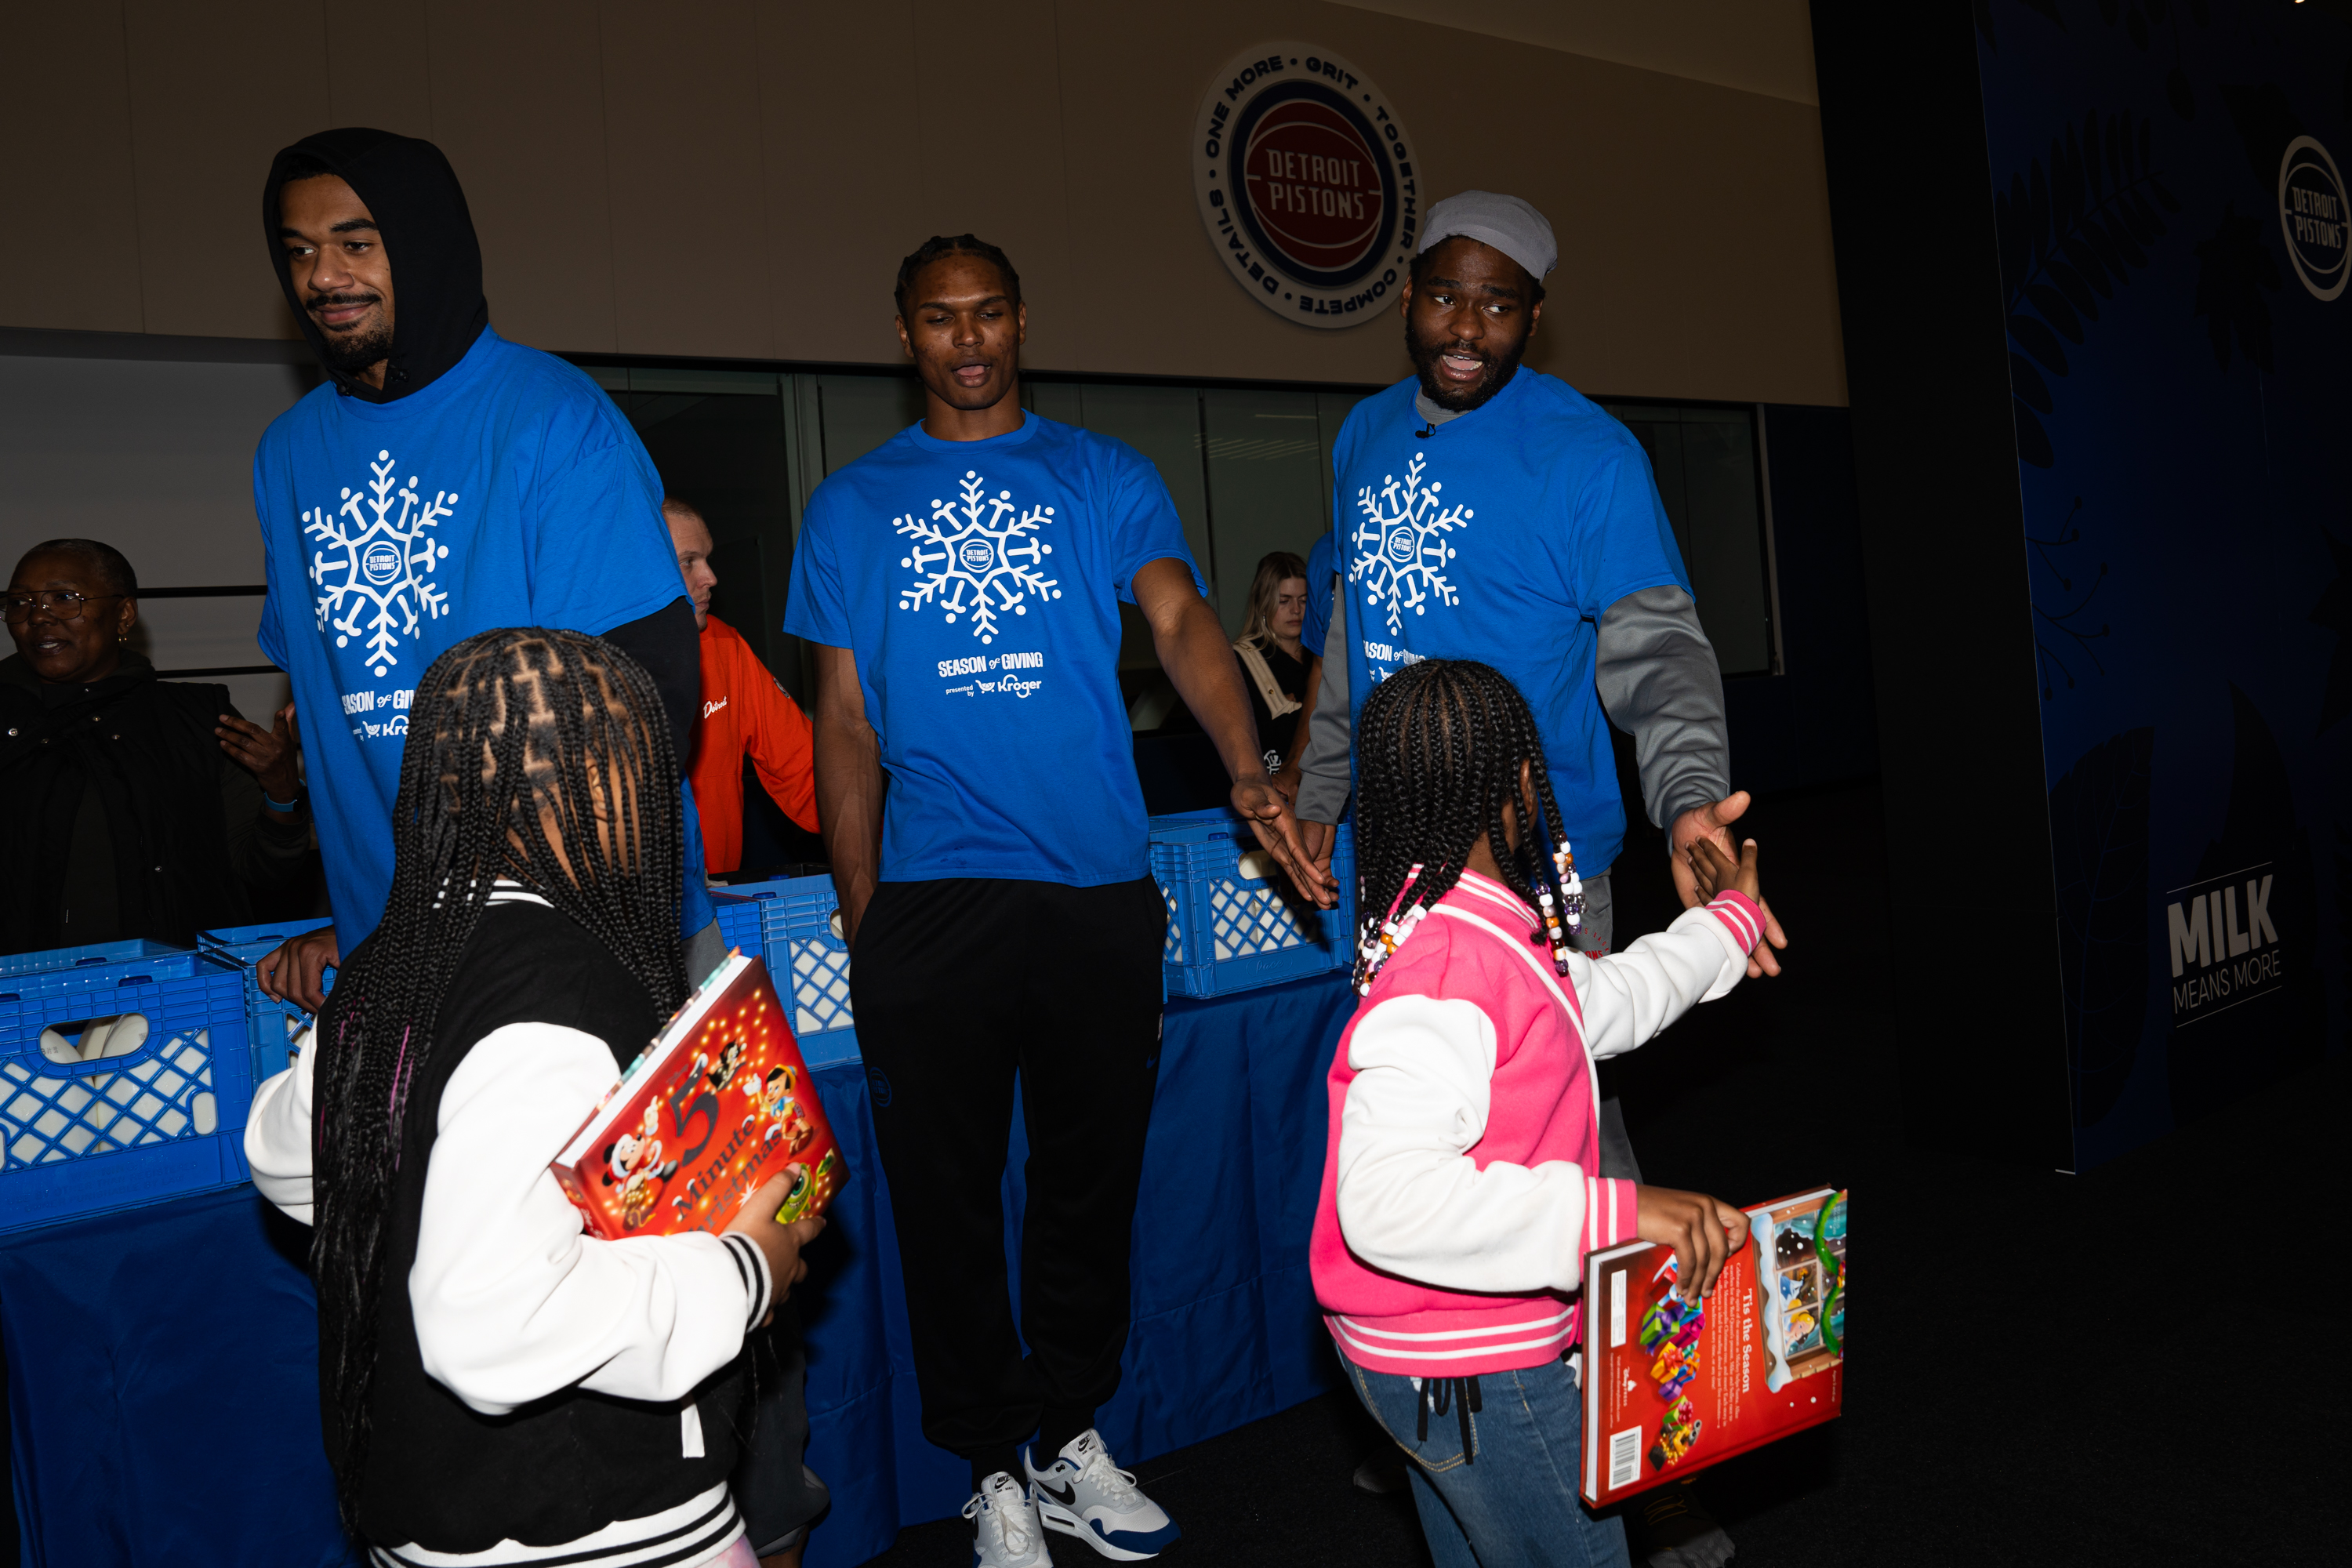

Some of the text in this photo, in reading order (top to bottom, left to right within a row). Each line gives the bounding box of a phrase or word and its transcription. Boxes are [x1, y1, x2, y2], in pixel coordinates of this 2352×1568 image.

[1305, 57, 1358, 89] GRIT
[1205, 56, 1283, 158] ONE MORE
[1265, 148, 1360, 187] DETROIT
[1376, 106, 1416, 249] TOGETHER
[1267, 181, 1364, 220] PISTONS
[2292, 187, 2338, 220] DETROIT
[1209, 189, 1279, 294] DETAILS
[2294, 215, 2342, 249] PISTONS
[1300, 269, 1397, 314] COMPETE
[369, 554, 395, 564] DETROIT
[369, 562, 396, 572] PISTONS
[938, 652, 1044, 677] SEASON of GIVING
[1394, 651, 1403, 661] of
[376, 695, 392, 708] of
[946, 684, 973, 695] presented
[997, 674, 1042, 699] Kroger
[703, 695, 728, 719] Detroit
[2167, 873, 2279, 978] MILK
[2173, 949, 2281, 1014] MEANS MORE
[670, 1053, 720, 1167] 5
[675, 1117, 757, 1218] Minute
[688, 1129, 783, 1234] hristmas
[1742, 1287, 1753, 1394] 'Tis the Season
[1078, 1434, 1091, 1446] NIKE
[996, 1475, 1011, 1484] NIKE
